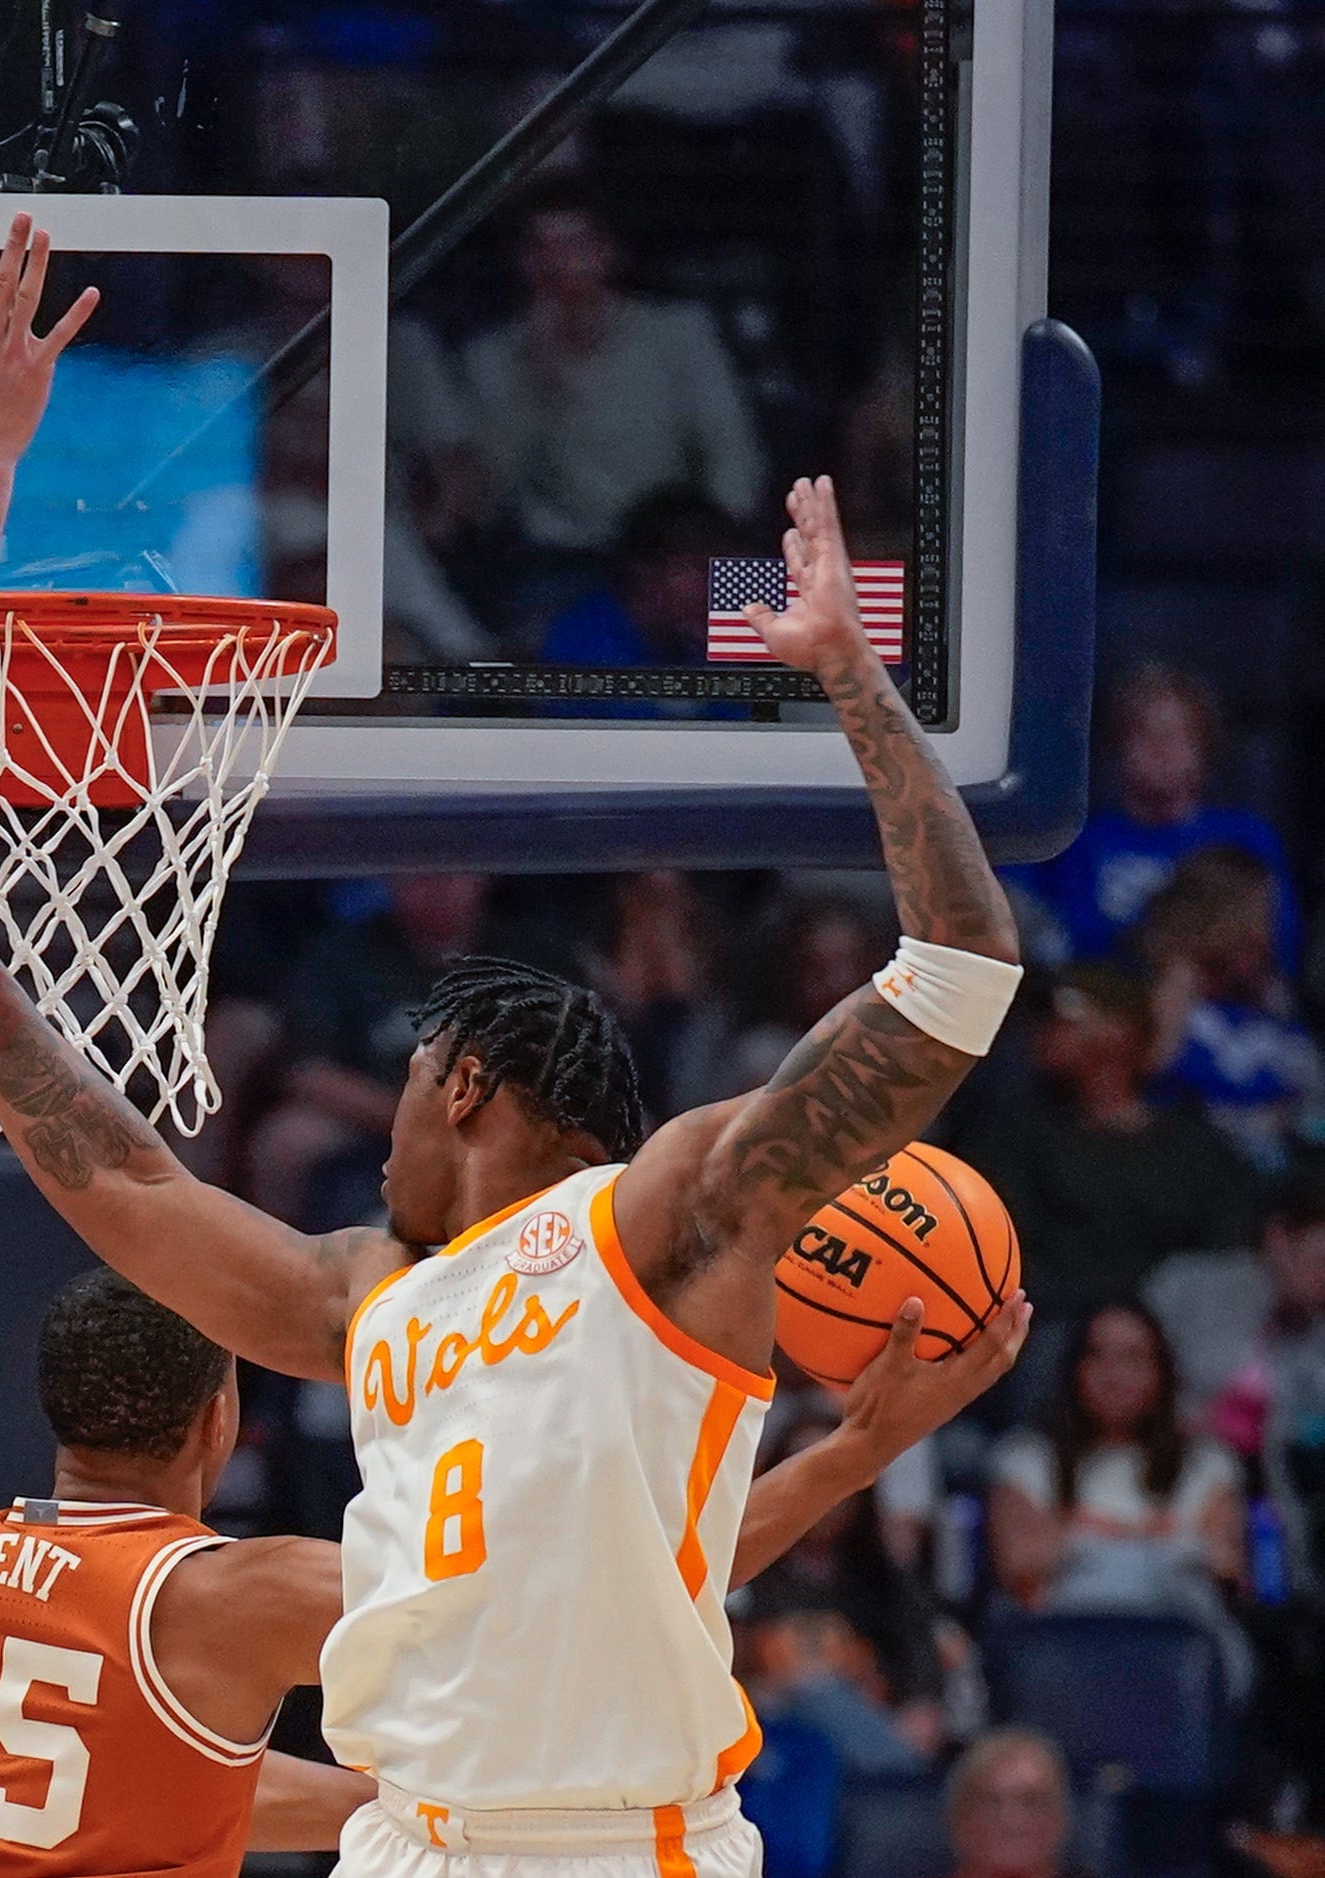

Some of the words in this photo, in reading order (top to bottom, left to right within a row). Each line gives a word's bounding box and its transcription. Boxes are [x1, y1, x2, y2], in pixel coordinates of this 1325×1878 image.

[853, 1160, 938, 1242] son
[512, 1246, 574, 1273] GRADUATE
[519, 1212, 569, 1258] SEC
[792, 1226, 873, 1288] CAA
[363, 1272, 581, 1426] Vols
[424, 1438, 487, 1582] 8
[416, 1802, 450, 1850] T
